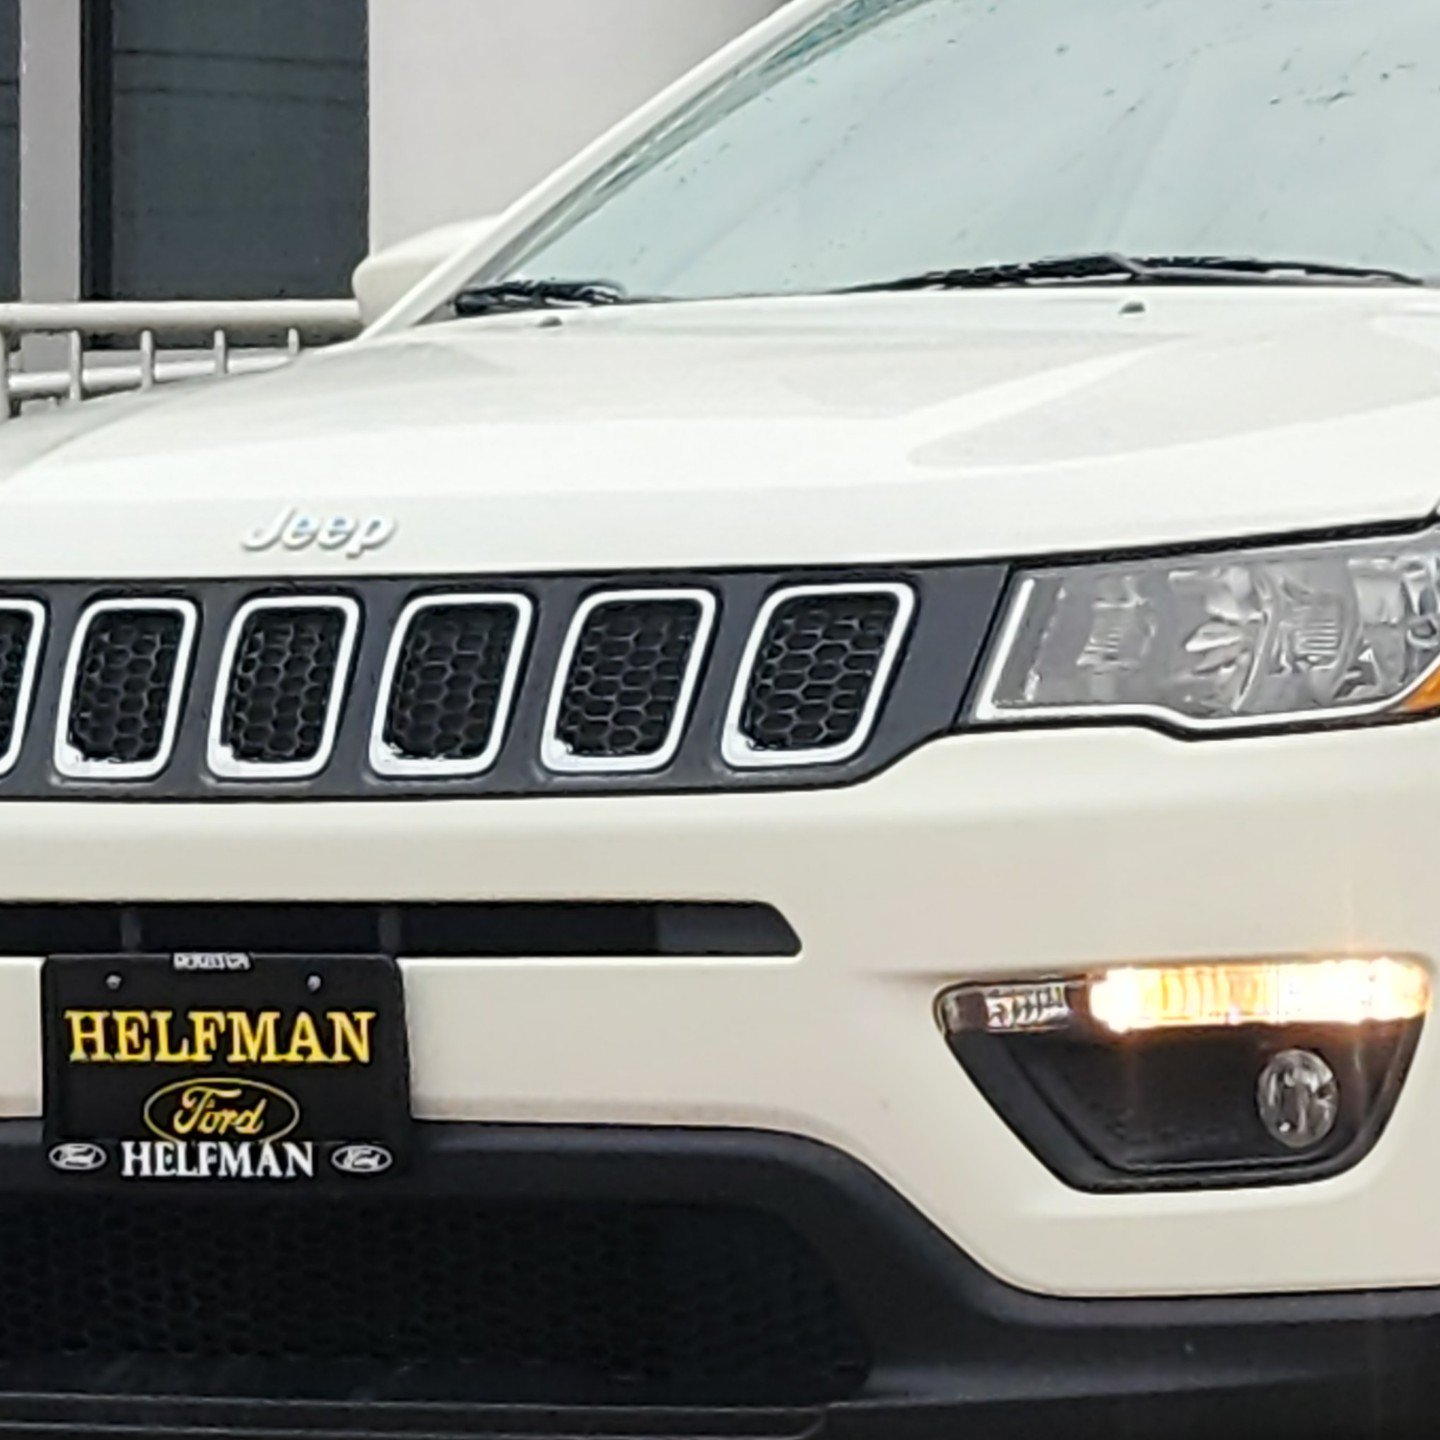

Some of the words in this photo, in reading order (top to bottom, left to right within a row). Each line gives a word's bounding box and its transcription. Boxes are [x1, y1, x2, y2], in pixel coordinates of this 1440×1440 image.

[241, 505, 398, 560] Jeep
[64, 1008, 376, 1064] HELFMAN
[172, 1085, 267, 1136] Ford
[120, 1140, 314, 1179] HELFMAN
